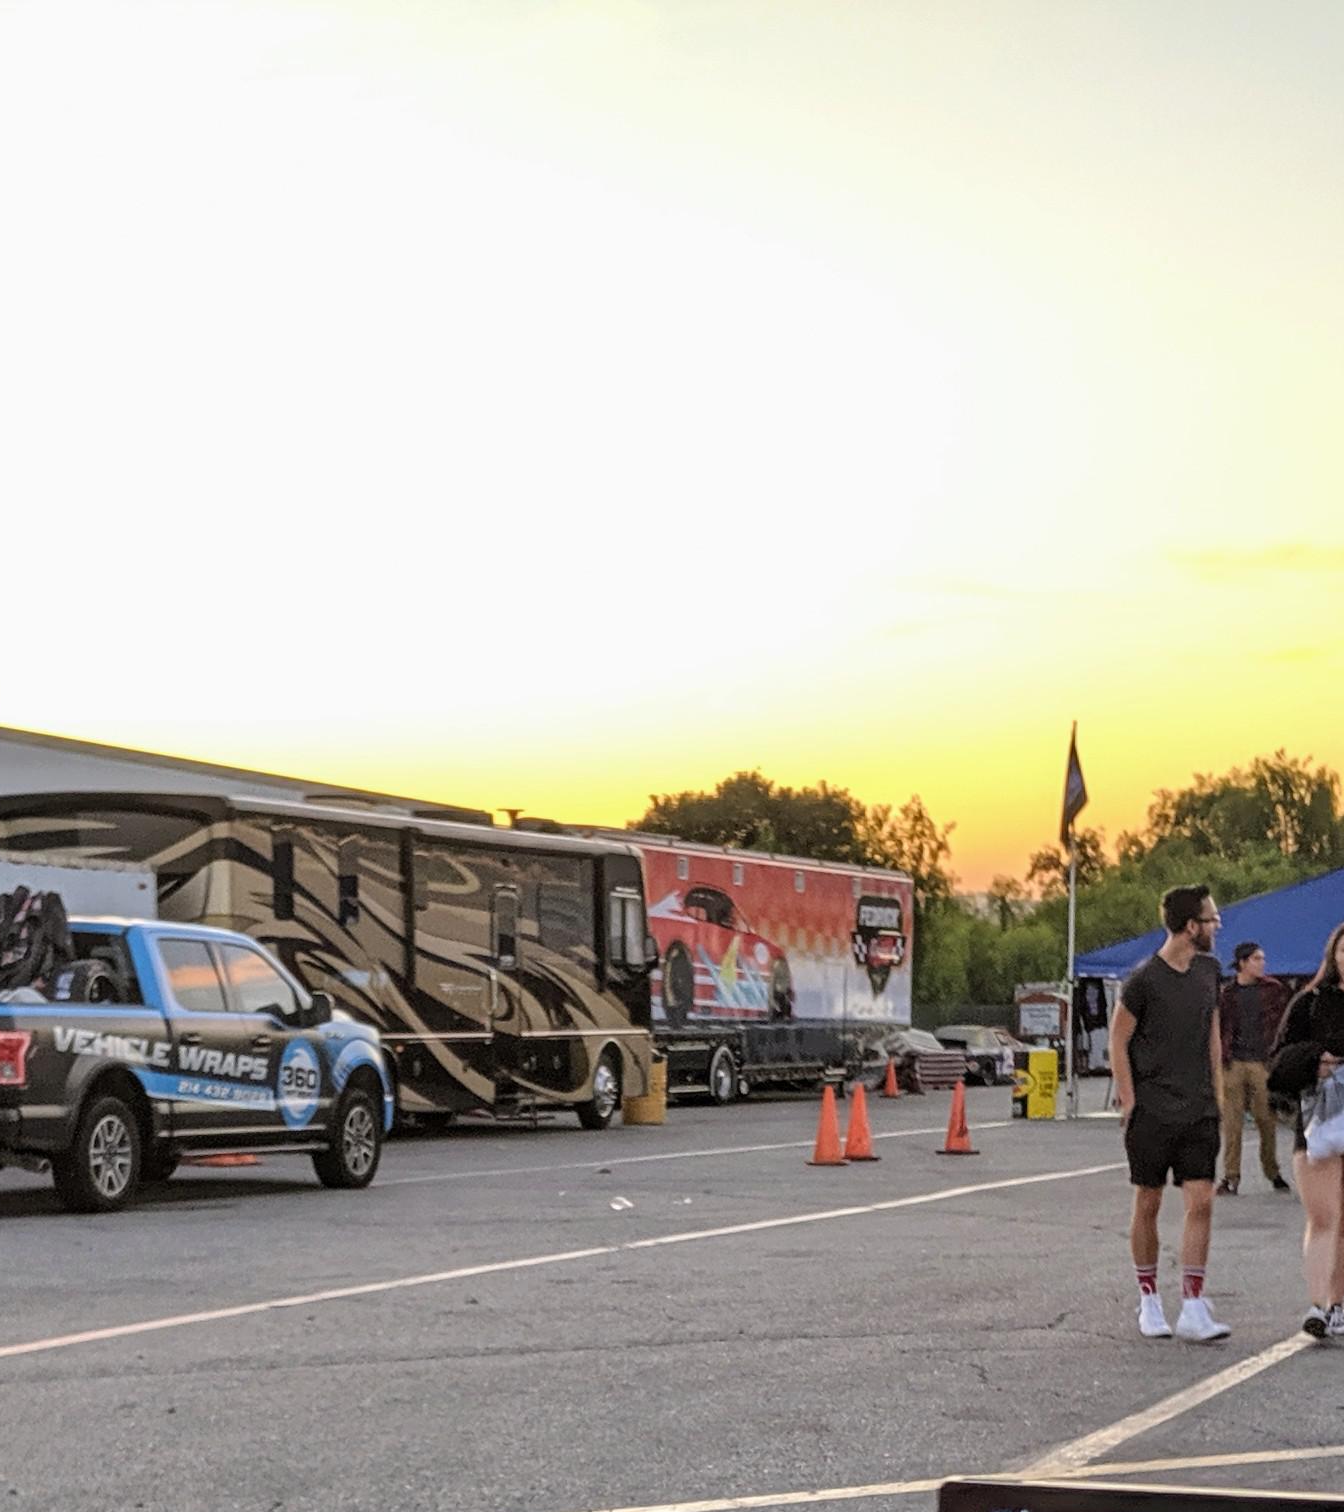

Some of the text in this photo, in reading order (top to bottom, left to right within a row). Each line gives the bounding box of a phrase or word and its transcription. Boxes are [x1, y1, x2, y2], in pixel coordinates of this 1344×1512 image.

[53, 1026, 270, 1081] VEHICLE WRAPS
[281, 1065, 318, 1090] 360
